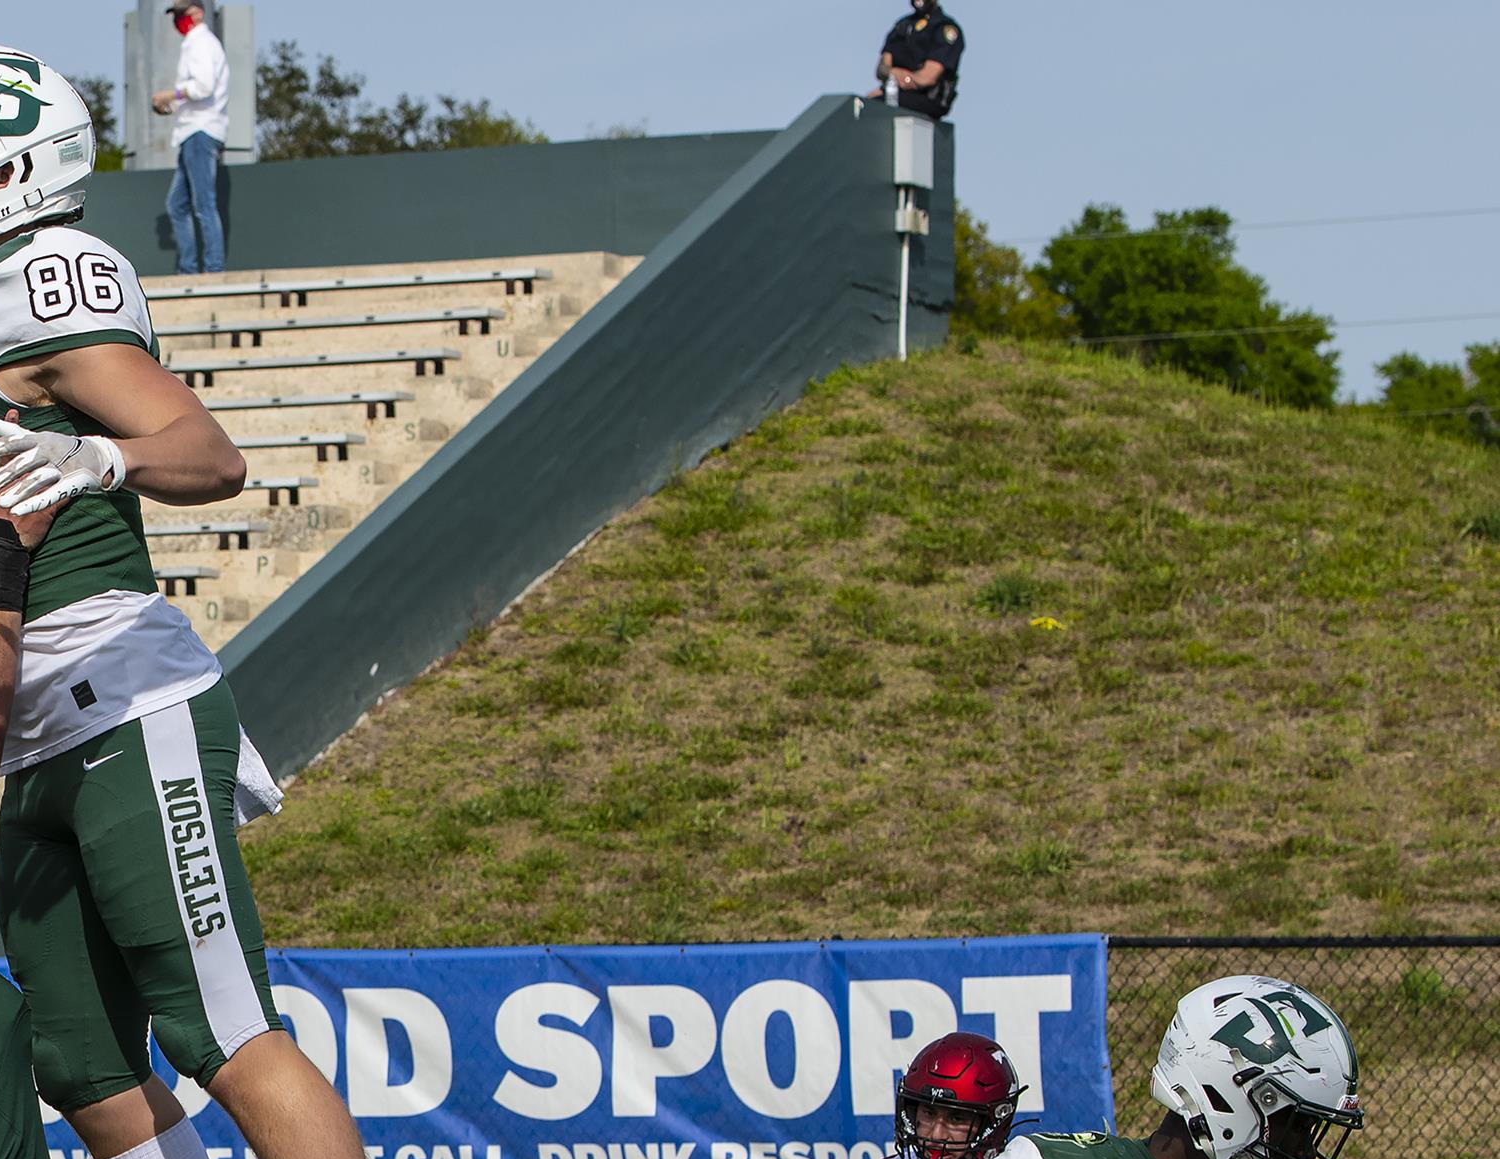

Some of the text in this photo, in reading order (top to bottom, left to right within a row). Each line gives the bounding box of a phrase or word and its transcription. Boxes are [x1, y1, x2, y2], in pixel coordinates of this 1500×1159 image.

[24, 252, 124, 323] 86
[404, 423, 416, 440] S
[256, 554, 269, 574] P
[161, 777, 226, 938] STETSON
[493, 973, 1072, 1121] SPORT
[931, 1087, 944, 1098] WC
